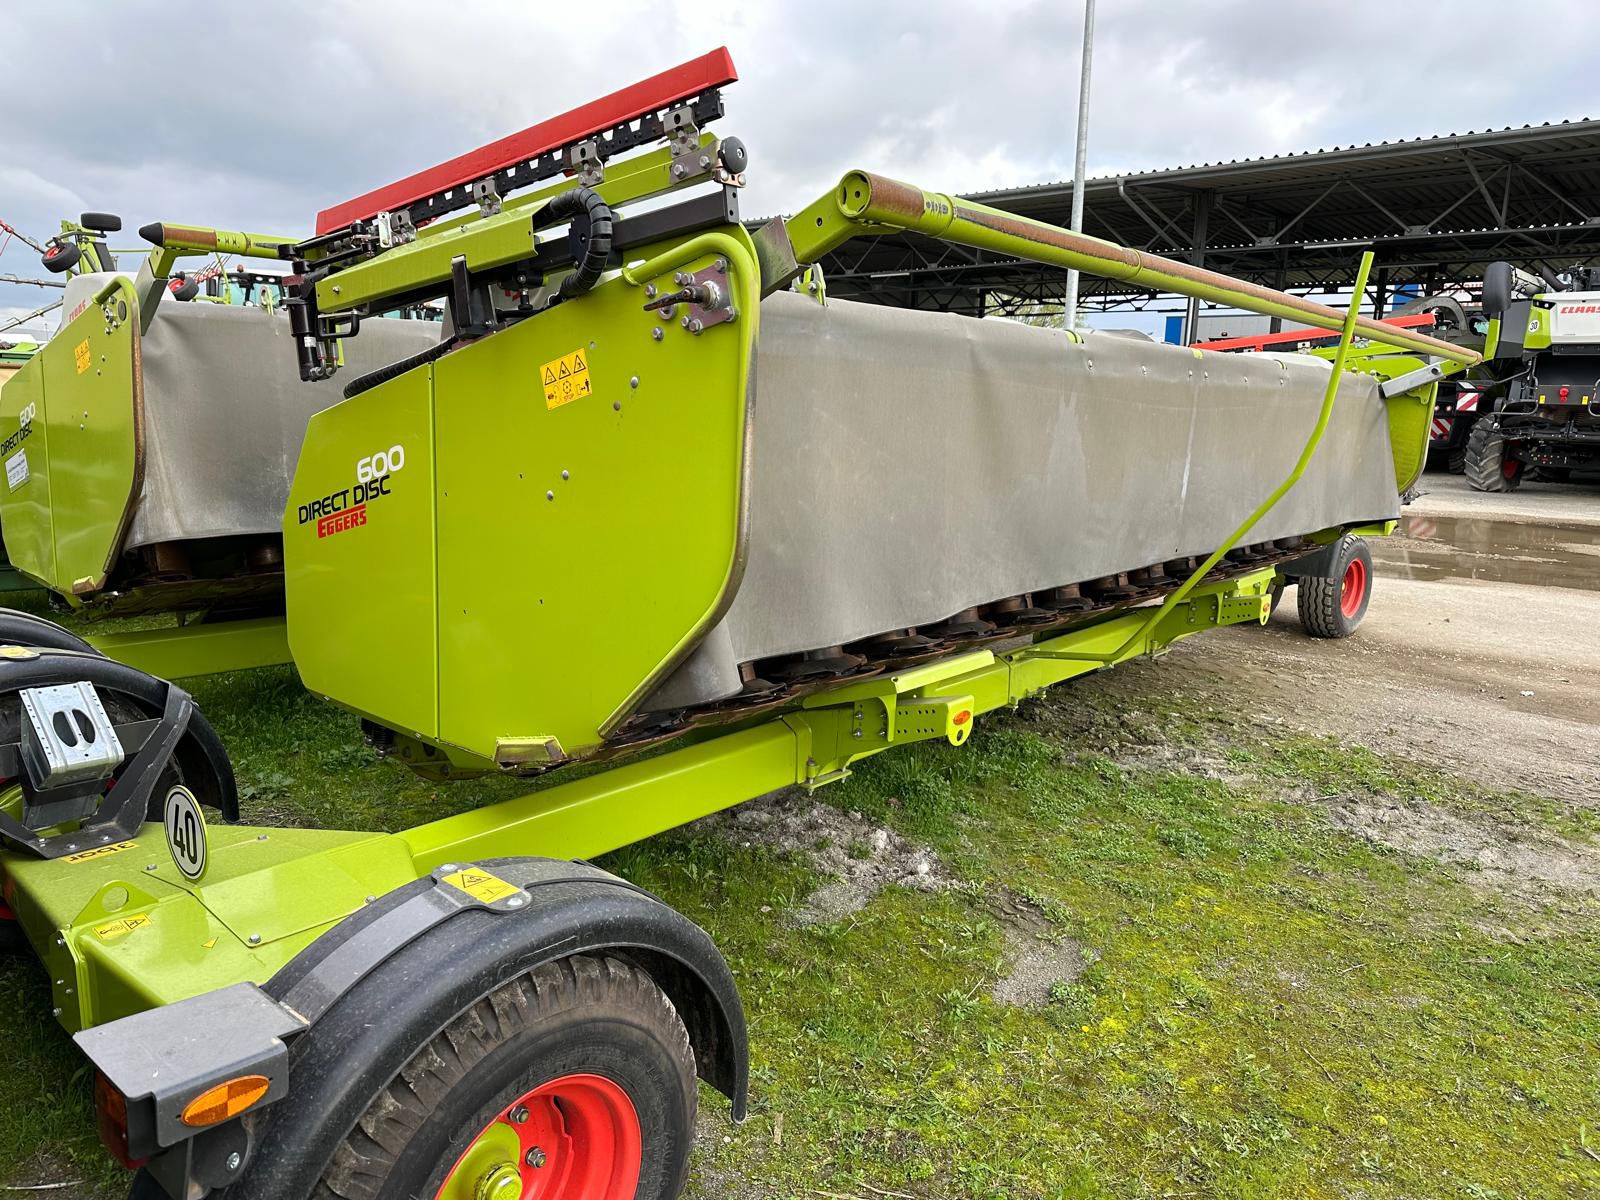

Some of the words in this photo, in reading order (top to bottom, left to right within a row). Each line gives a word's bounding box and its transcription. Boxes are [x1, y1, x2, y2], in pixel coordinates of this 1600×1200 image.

[1530, 321, 1538, 331] 30
[20, 401, 36, 427] 600
[0, 431, 19, 457] DIRECT
[19, 420, 33, 441] DISC
[357, 444, 405, 483] 600
[298, 489, 350, 525] DIRECT
[353, 474, 392, 506] DISC
[317, 503, 368, 539] EGGERS
[173, 804, 198, 865] 40
